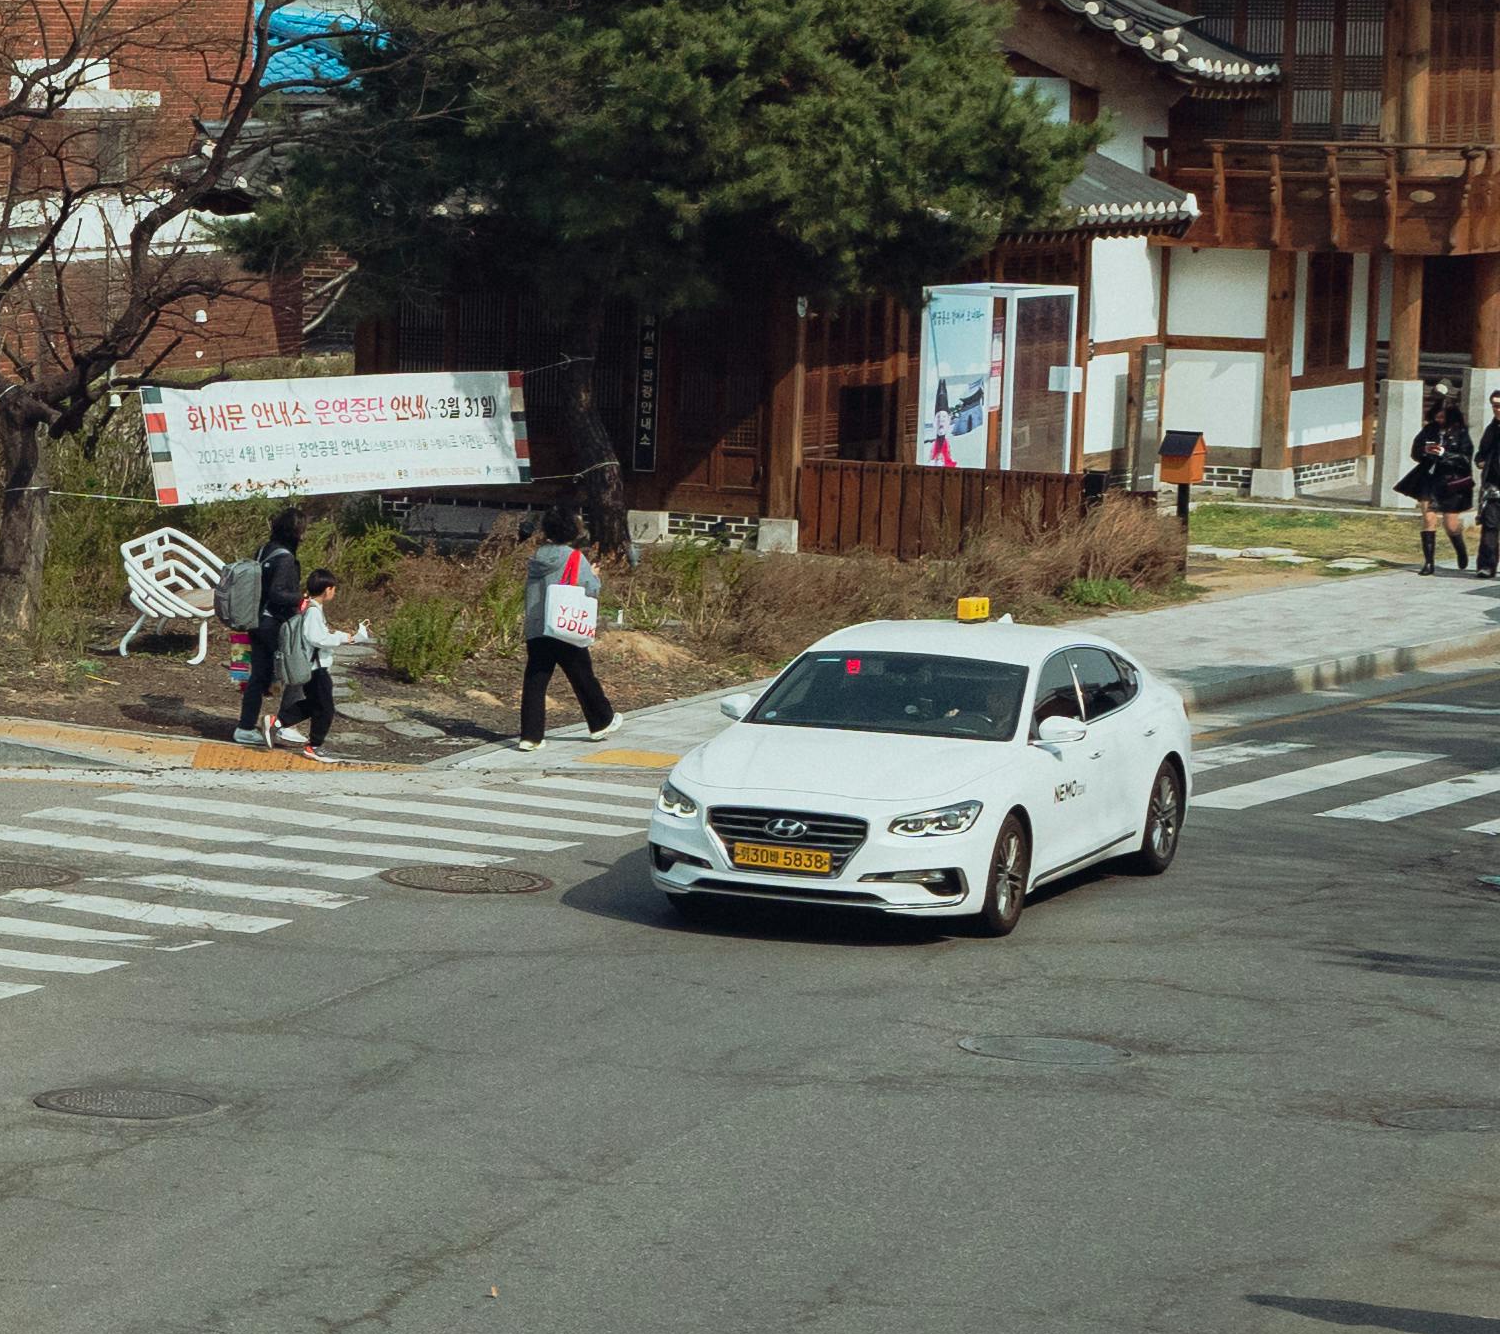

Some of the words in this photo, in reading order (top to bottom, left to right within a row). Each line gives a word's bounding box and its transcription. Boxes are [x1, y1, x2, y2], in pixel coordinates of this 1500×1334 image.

[187, 404, 247, 433] 화서문
[251, 400, 312, 429] 안내소
[314, 397, 388, 426] 운영중단
[197, 447, 236, 464] 2025년
[239, 445, 257, 463] 4월
[298, 439, 338, 459] 장안공원
[783, 851, 824, 869] 5838
